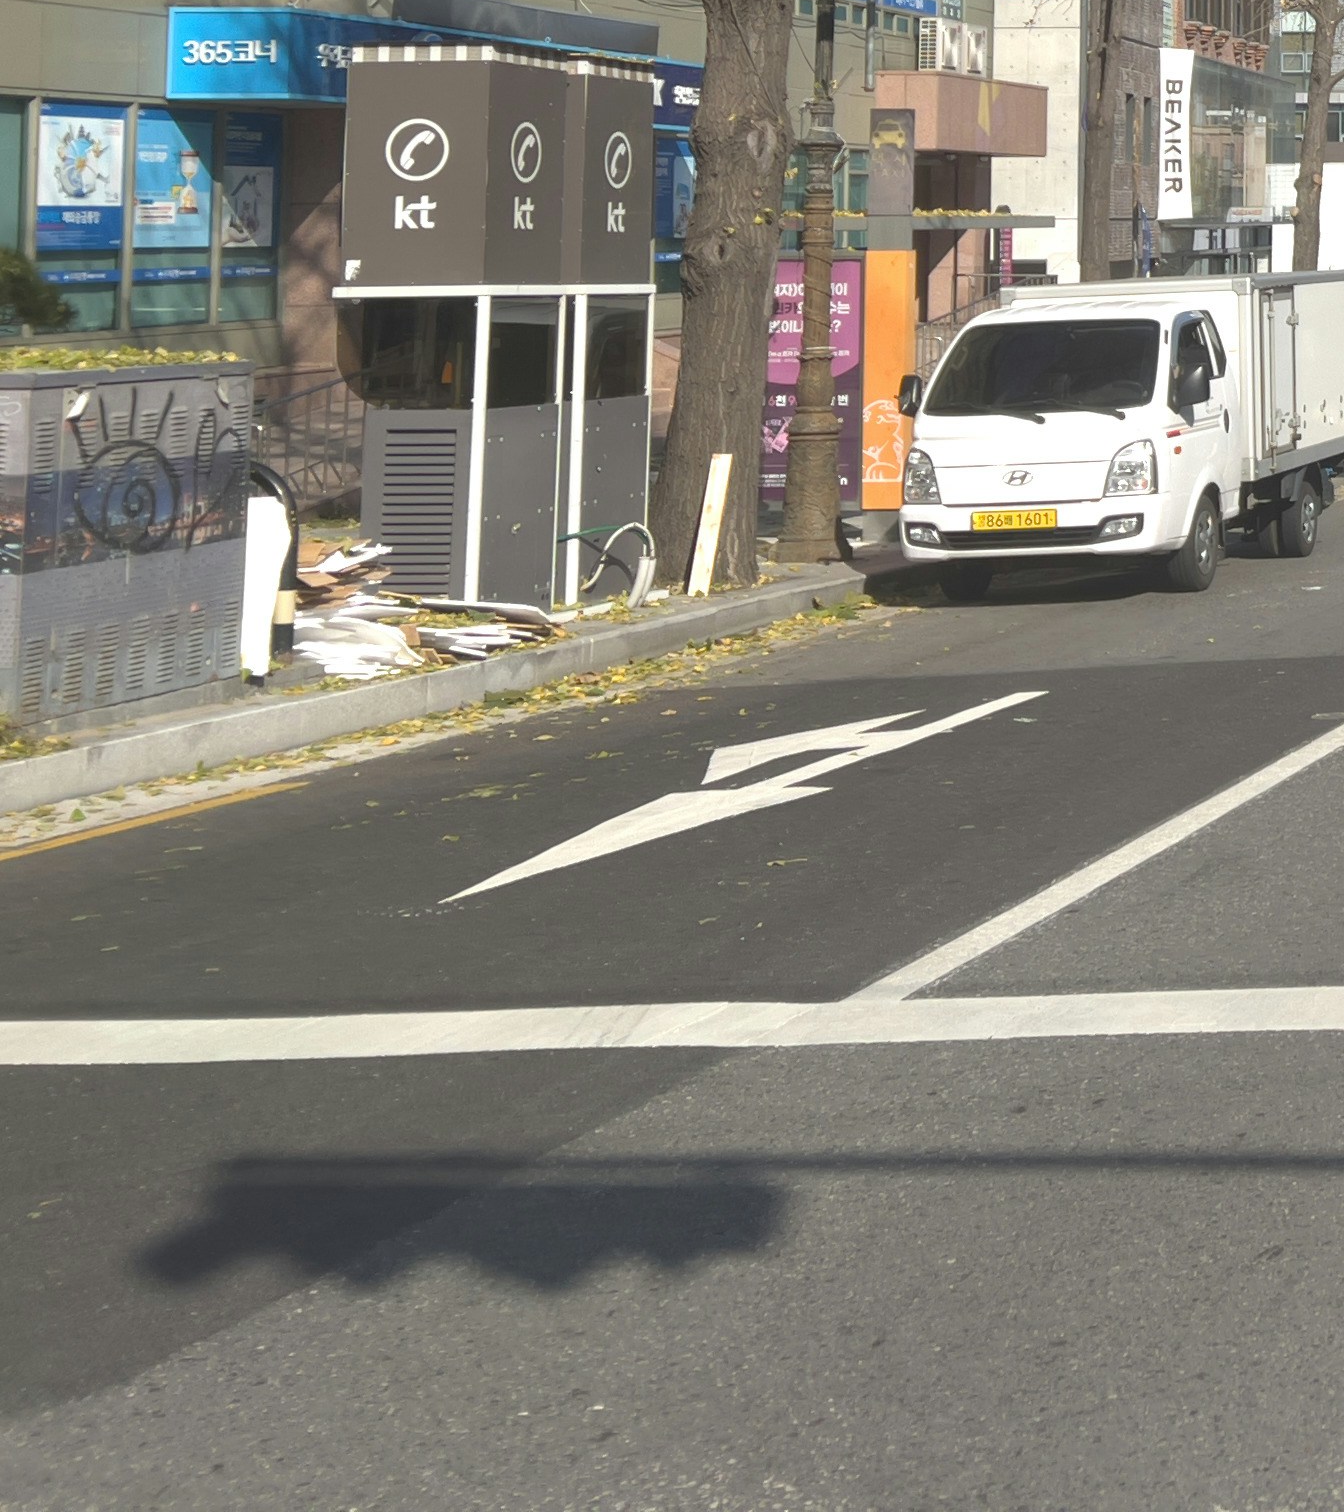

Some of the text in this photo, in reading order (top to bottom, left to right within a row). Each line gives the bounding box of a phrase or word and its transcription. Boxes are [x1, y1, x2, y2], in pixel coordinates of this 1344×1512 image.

[182, 39, 278, 65] 365코너
[1164, 79, 1183, 194] BEAKER
[394, 195, 437, 230] kt
[513, 196, 535, 230] kt
[607, 201, 626, 233] kt
